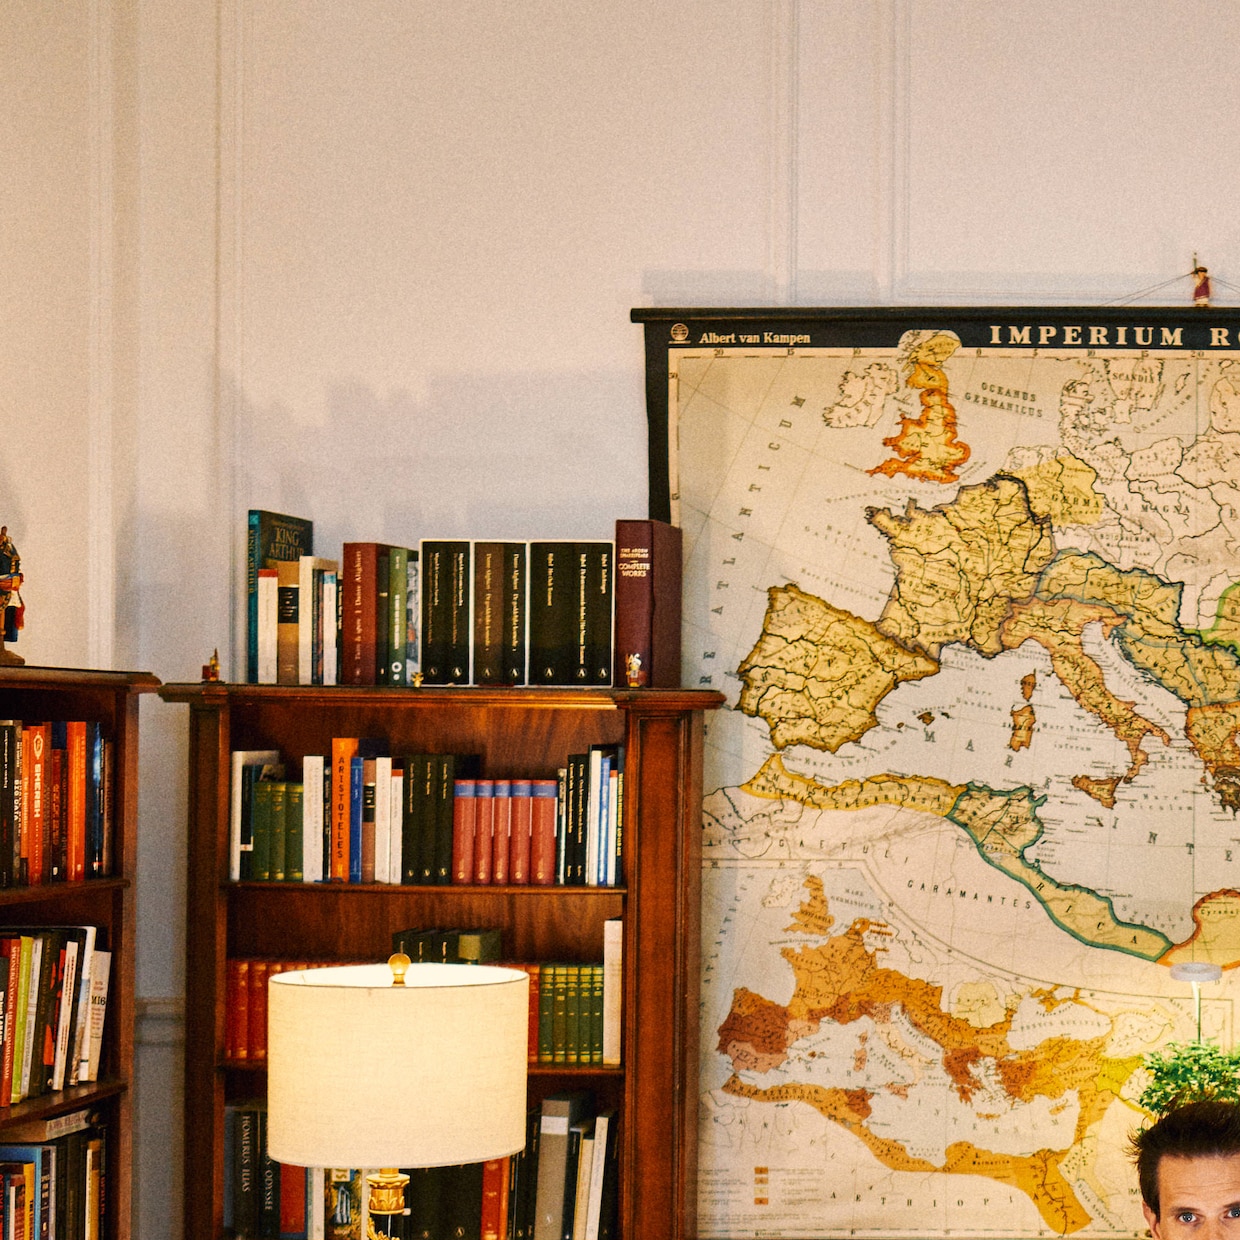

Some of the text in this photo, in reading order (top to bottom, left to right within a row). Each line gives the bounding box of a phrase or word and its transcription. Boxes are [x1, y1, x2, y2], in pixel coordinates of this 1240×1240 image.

[699, 332, 811, 346] Albert van Kampen
[989, 325, 1184, 347] IMPERIUM
[1112, 371, 1155, 384] SCANDIA
[964, 392, 1044, 418] GERMANICUS
[980, 382, 1037, 402] OCEANUS
[275, 527, 301, 547] KING
[269, 543, 305, 562] ARTHUR
[353, 550, 364, 608] Dante Alighieri
[34, 764, 42, 817] SMERSH
[336, 756, 345, 859] ARISTOTELES
[779, 839, 909, 865] GAETULI
[907, 880, 1032, 910] GARAMANTES
[10, 945, 18, 985] SPIONEREN
[91, 995, 106, 1006] MI6
[242, 1114, 252, 1192] HOMERUS ILIAS
[264, 1169, 274, 1211] ODYSSEE
